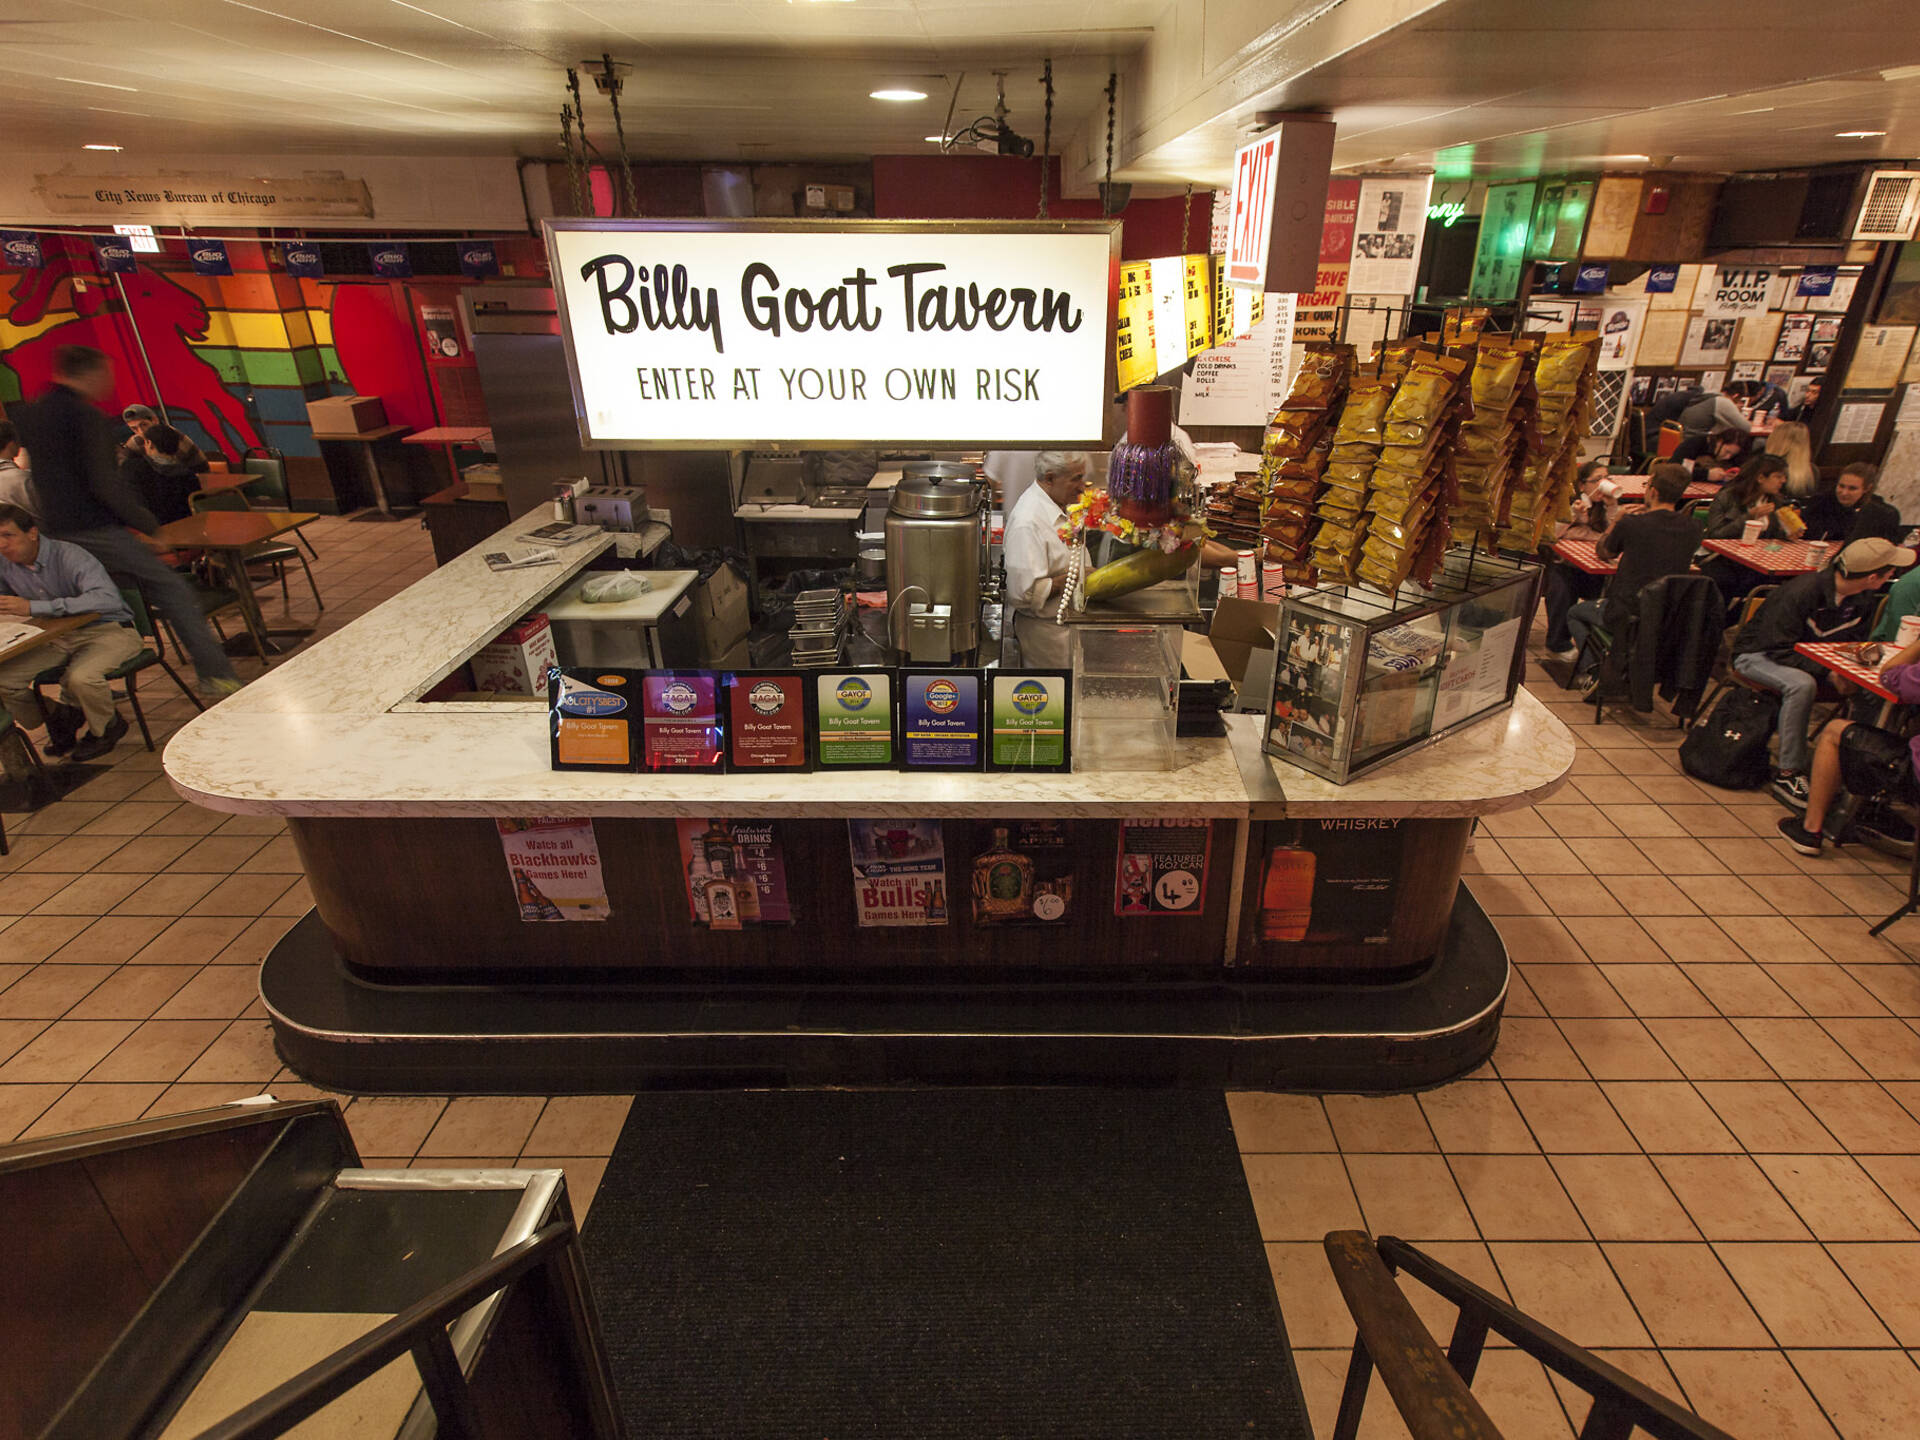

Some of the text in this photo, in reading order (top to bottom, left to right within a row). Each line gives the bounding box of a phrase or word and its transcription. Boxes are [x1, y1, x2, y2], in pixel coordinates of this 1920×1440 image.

[95, 189, 124, 206] City
[125, 189, 161, 203] News
[163, 190, 209, 204] Bureau
[212, 190, 225, 204] of
[227, 191, 277, 207] Chicago
[1232, 140, 1274, 262] EXIT
[1315, 271, 1348, 287] ERVE
[1722, 270, 1770, 288] V.I.P.
[1716, 290, 1765, 302] ROOM
[580, 254, 1084, 354] Billy Goat Tavern
[1313, 311, 1333, 321] OUR
[638, 367, 1041, 402] ENTER AT YOUR OWN RISK
[666, 694, 694, 702] ZAGAT
[753, 694, 782, 702] ZAGAT
[841, 690, 865, 698] GAYOT
[566, 722, 579, 730] Billy
[744, 723, 756, 731] Billy
[829, 717, 881, 726] Billy Goat Tavern
[918, 719, 930, 727] Billy
[1006, 718, 1017, 726] Billy
[731, 824, 774, 836] featured
[1320, 818, 1400, 831] WHISKEY
[737, 833, 773, 844] DRINKS
[526, 839, 573, 850] Watch all
[509, 853, 598, 867] Blackhawks
[1154, 854, 1204, 862] FEATURED
[526, 869, 587, 879] Games Here!
[869, 877, 918, 887] Watch all
[862, 886, 927, 908] Bulls
[1162, 882, 1182, 904] 4
[864, 911, 898, 920] Games
